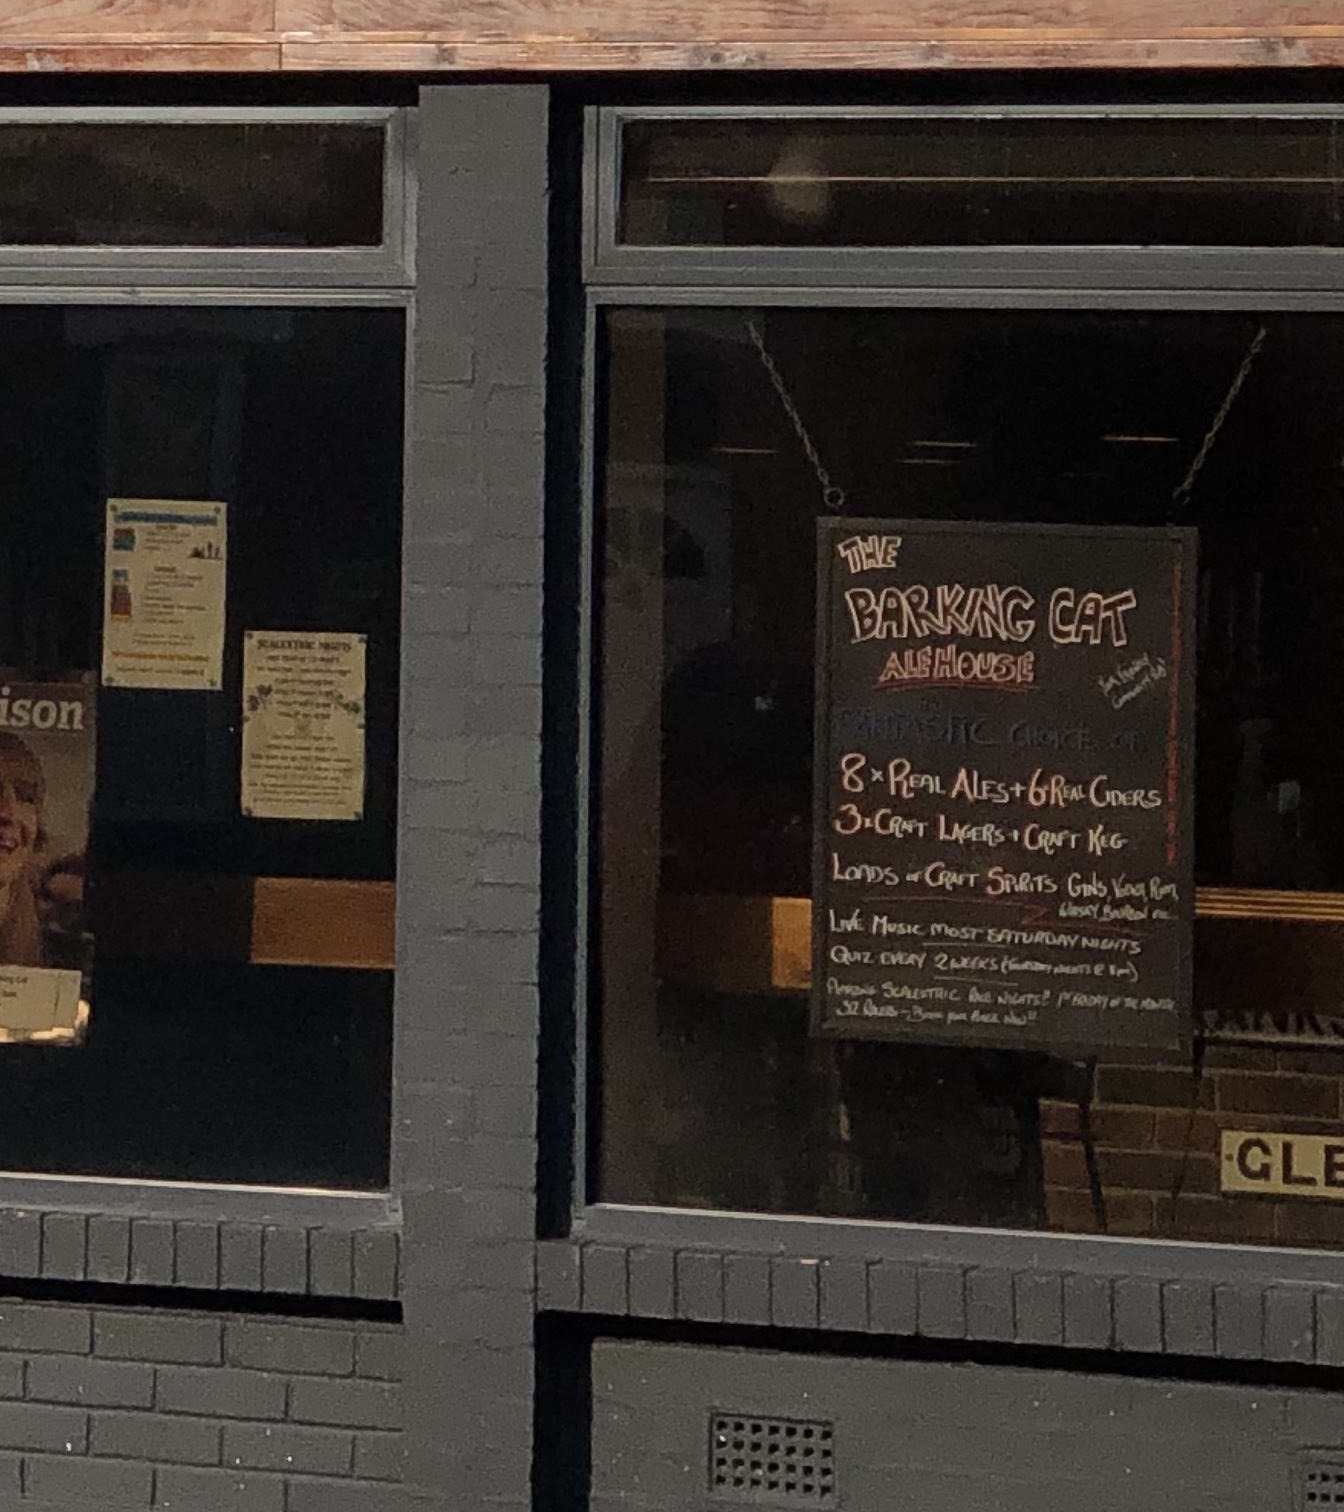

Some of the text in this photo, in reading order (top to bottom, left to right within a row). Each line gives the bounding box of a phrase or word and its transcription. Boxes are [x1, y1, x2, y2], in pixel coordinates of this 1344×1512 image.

[837, 534, 902, 575] THE
[845, 583, 1137, 647] BARKING CAT
